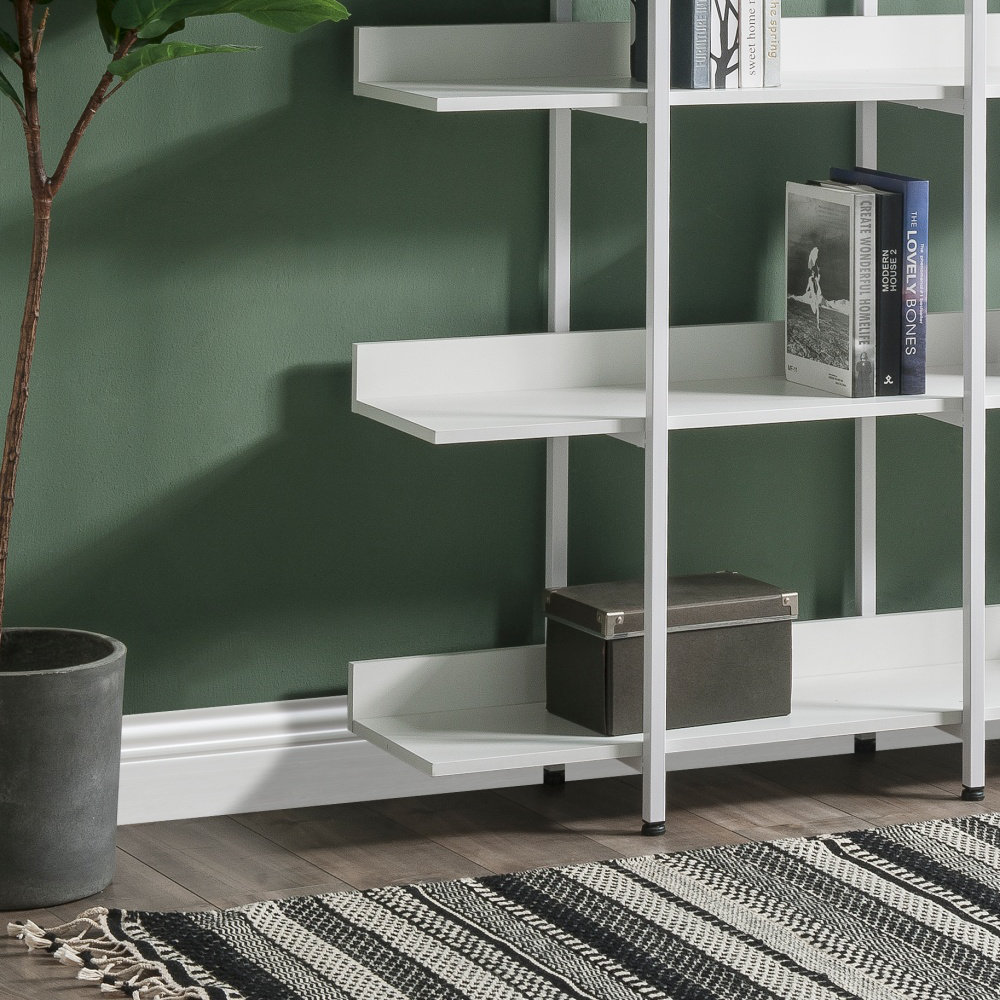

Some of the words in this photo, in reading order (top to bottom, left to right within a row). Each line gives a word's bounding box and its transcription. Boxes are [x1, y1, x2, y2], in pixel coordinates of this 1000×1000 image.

[696, 15, 707, 67] FURNITURE
[747, 8, 757, 40] home
[768, 20, 778, 59] spring
[859, 200, 872, 234] CREATE
[859, 237, 872, 295] WONDERFUL
[906, 230, 918, 295] LOVELY
[858, 299, 871, 346] HOMELIFE
[905, 299, 917, 355] BONES
